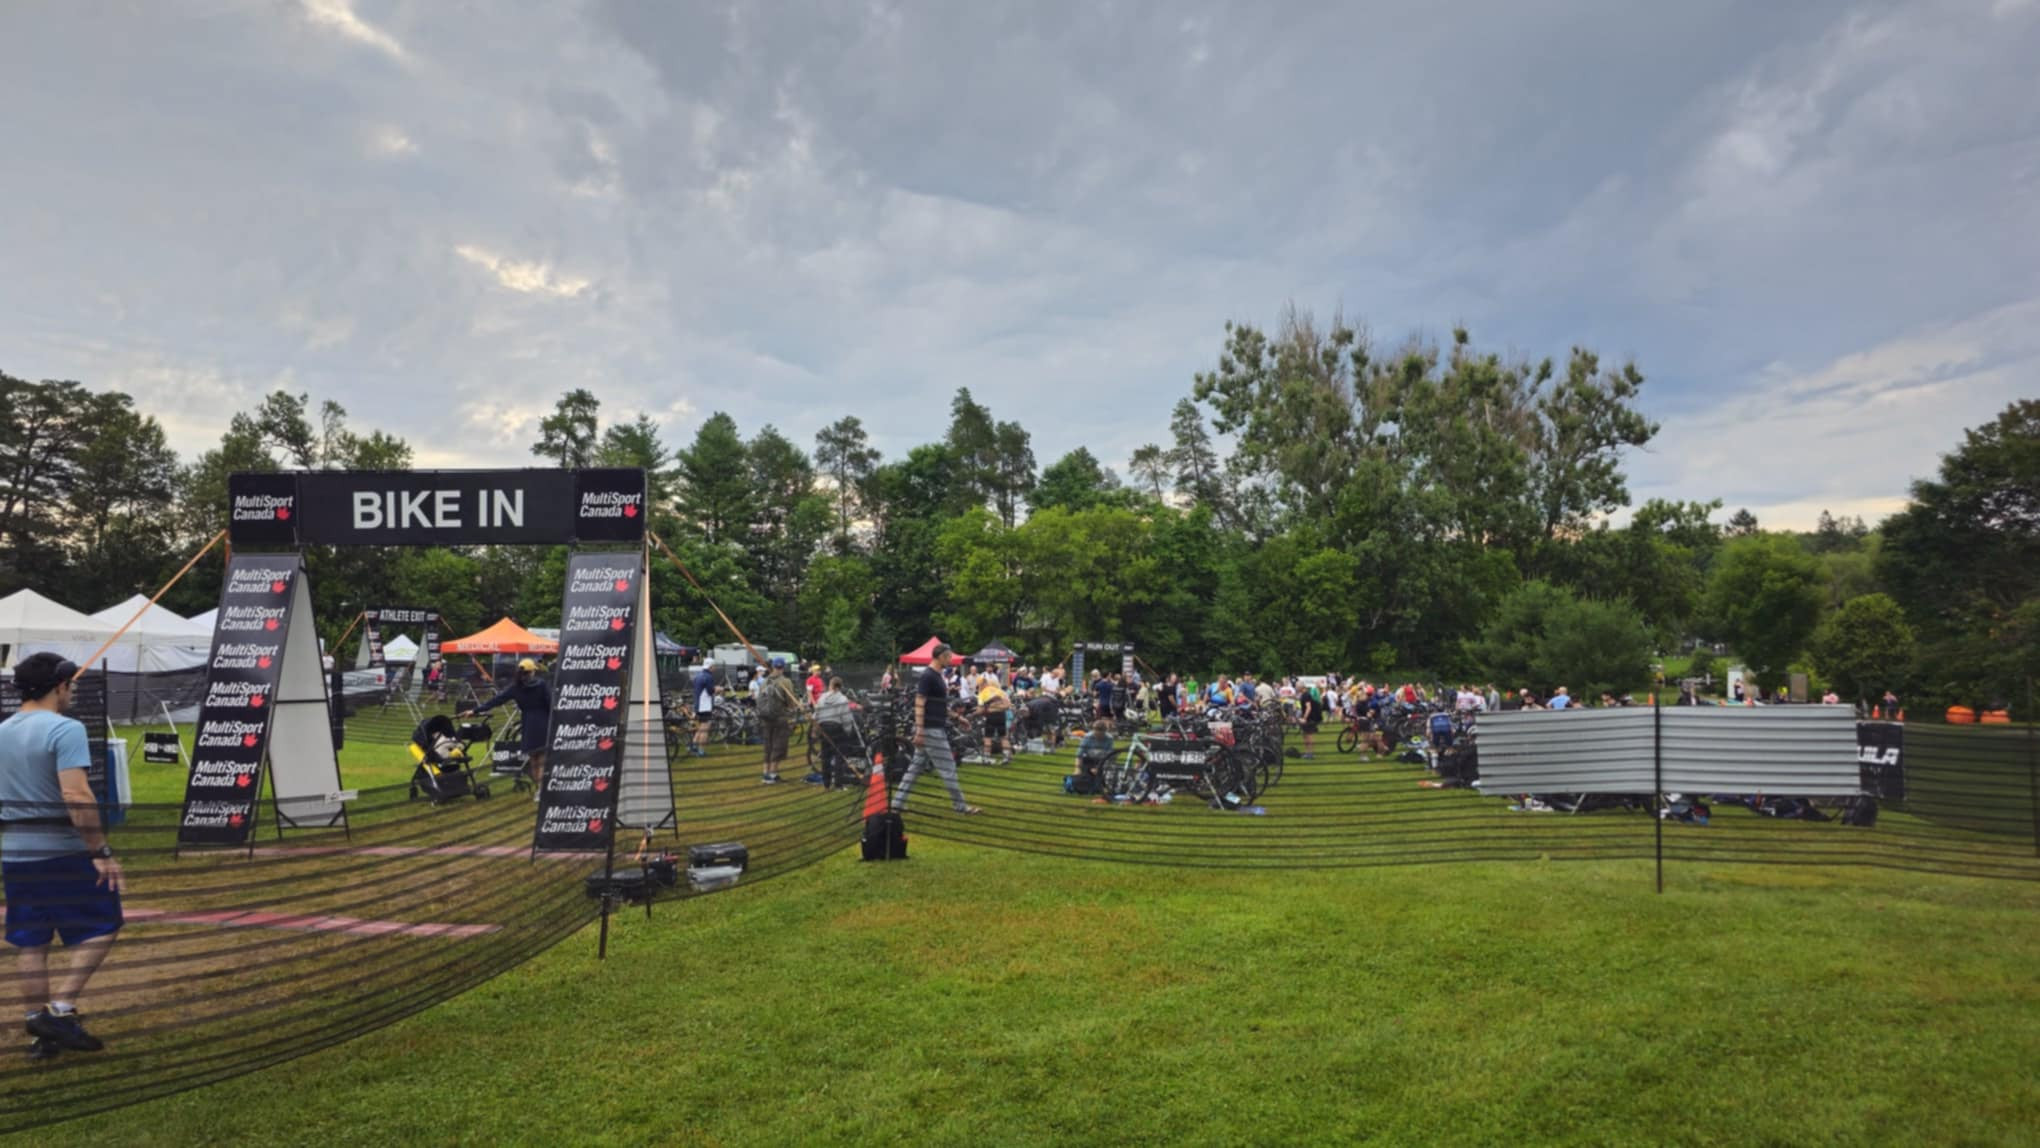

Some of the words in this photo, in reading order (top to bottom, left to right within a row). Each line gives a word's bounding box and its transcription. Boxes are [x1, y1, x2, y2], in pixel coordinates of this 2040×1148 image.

[234, 494, 293, 509] MultiSport
[580, 491, 641, 505] MultiSport
[233, 507, 275, 520] Canada
[353, 490, 462, 529] BIKE
[478, 489, 524, 528] IN
[579, 504, 622, 517] Canada
[231, 569, 291, 583] MultiSport
[573, 567, 634, 581] MultiSport
[228, 581, 271, 593] Canada
[570, 580, 613, 593] Canada
[224, 606, 286, 620] MultiSport
[380, 609, 409, 622] ATHLETE
[411, 610, 425, 622] EXIT
[569, 605, 630, 619] MultiSport
[220, 619, 264, 631] Canada
[566, 619, 609, 631] Canada
[217, 643, 278, 658] MultiSport
[564, 644, 627, 658] MultiSport
[1087, 642, 1103, 650] RUN
[1104, 643, 1120, 651] OUT
[212, 655, 257, 668] Canada
[561, 657, 606, 670] Canada
[209, 681, 271, 696] MultiSport
[205, 694, 249, 707] Canada
[202, 721, 264, 735] MultiSport
[556, 723, 618, 738] MultiSport
[198, 734, 242, 746] Canada
[552, 737, 597, 750] Canada
[195, 760, 258, 775] MultiSport
[551, 764, 615, 779] MultiSport
[191, 773, 236, 786] Canada
[547, 778, 592, 791] Canada
[188, 799, 250, 814] MultiSport
[545, 805, 610, 820] MultiSport
[183, 814, 229, 827] Canada
[541, 820, 587, 833] Canada
